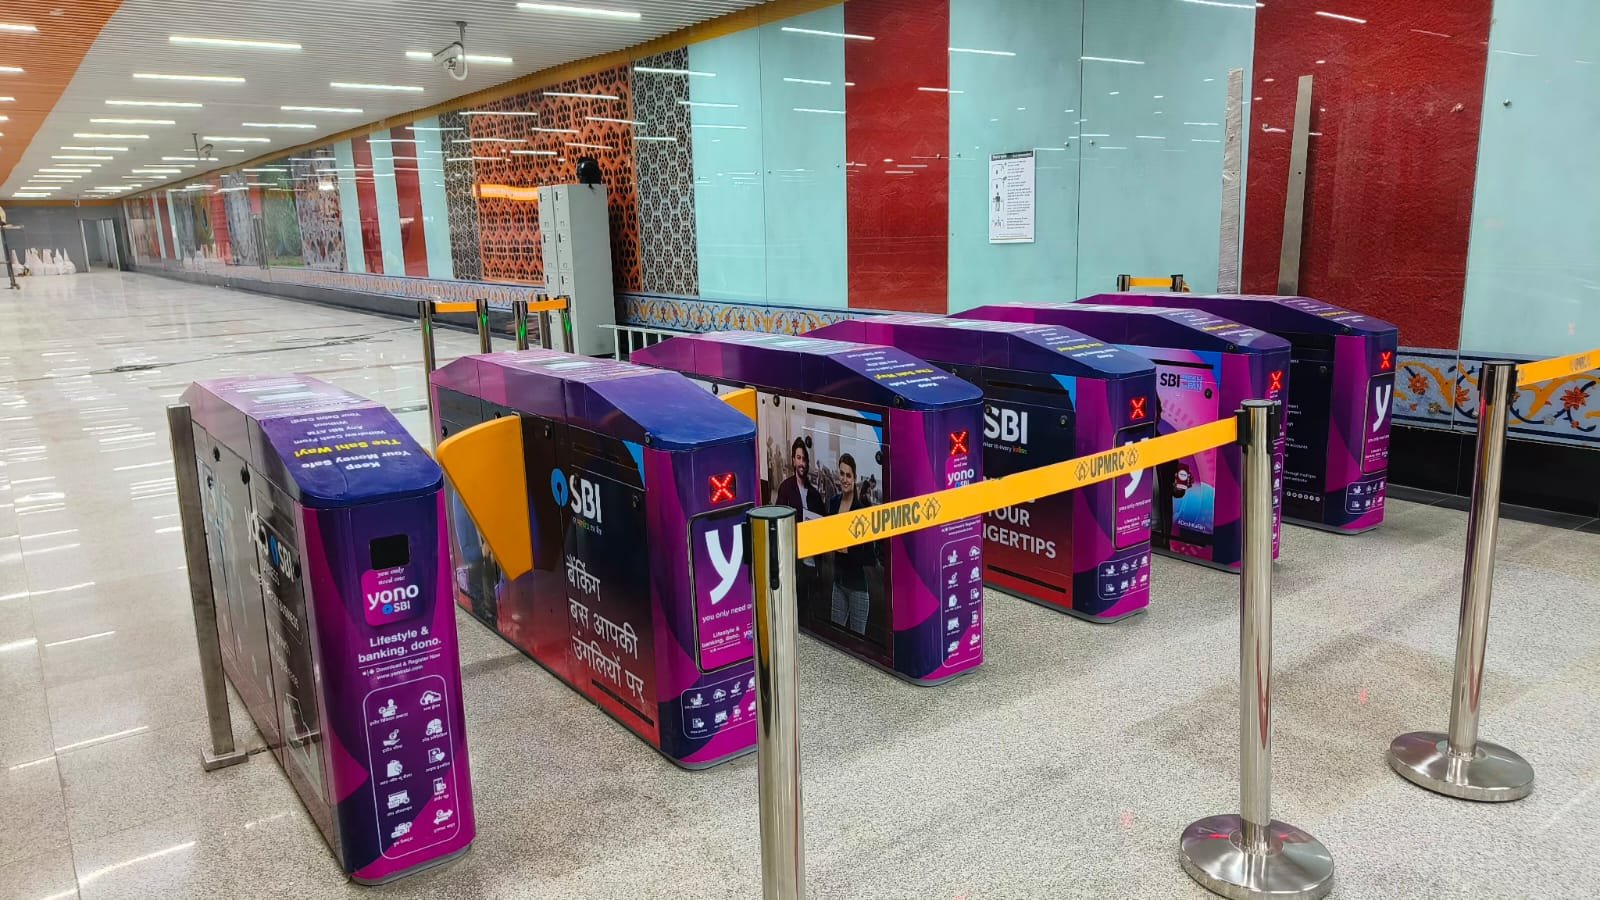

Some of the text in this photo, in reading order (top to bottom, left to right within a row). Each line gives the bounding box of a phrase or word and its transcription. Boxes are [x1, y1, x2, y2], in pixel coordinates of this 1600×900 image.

[1160, 372, 1180, 388] SBI
[983, 406, 1028, 445] SBI
[294, 438, 401, 458] The Sahi Way!
[301, 450, 411, 469] Your Money Safe
[345, 461, 380, 471] Keep
[1090, 450, 1125, 477] UPMRC
[947, 468, 975, 486] yono
[570, 475, 602, 524] SBI
[871, 501, 921, 534] UPMRC
[277, 541, 295, 583] SBI
[704, 524, 744, 606] y
[367, 584, 419, 611] yono
[393, 600, 411, 613] SBI
[702, 615, 715, 624] you
[715, 609, 730, 620] only
[730, 604, 746, 615] need
[369, 625, 429, 648] Lifestyle &
[569, 598, 638, 660] बस आपकी
[358, 637, 442, 663] banking, dono.
[571, 630, 644, 704] उंगलियों पर
